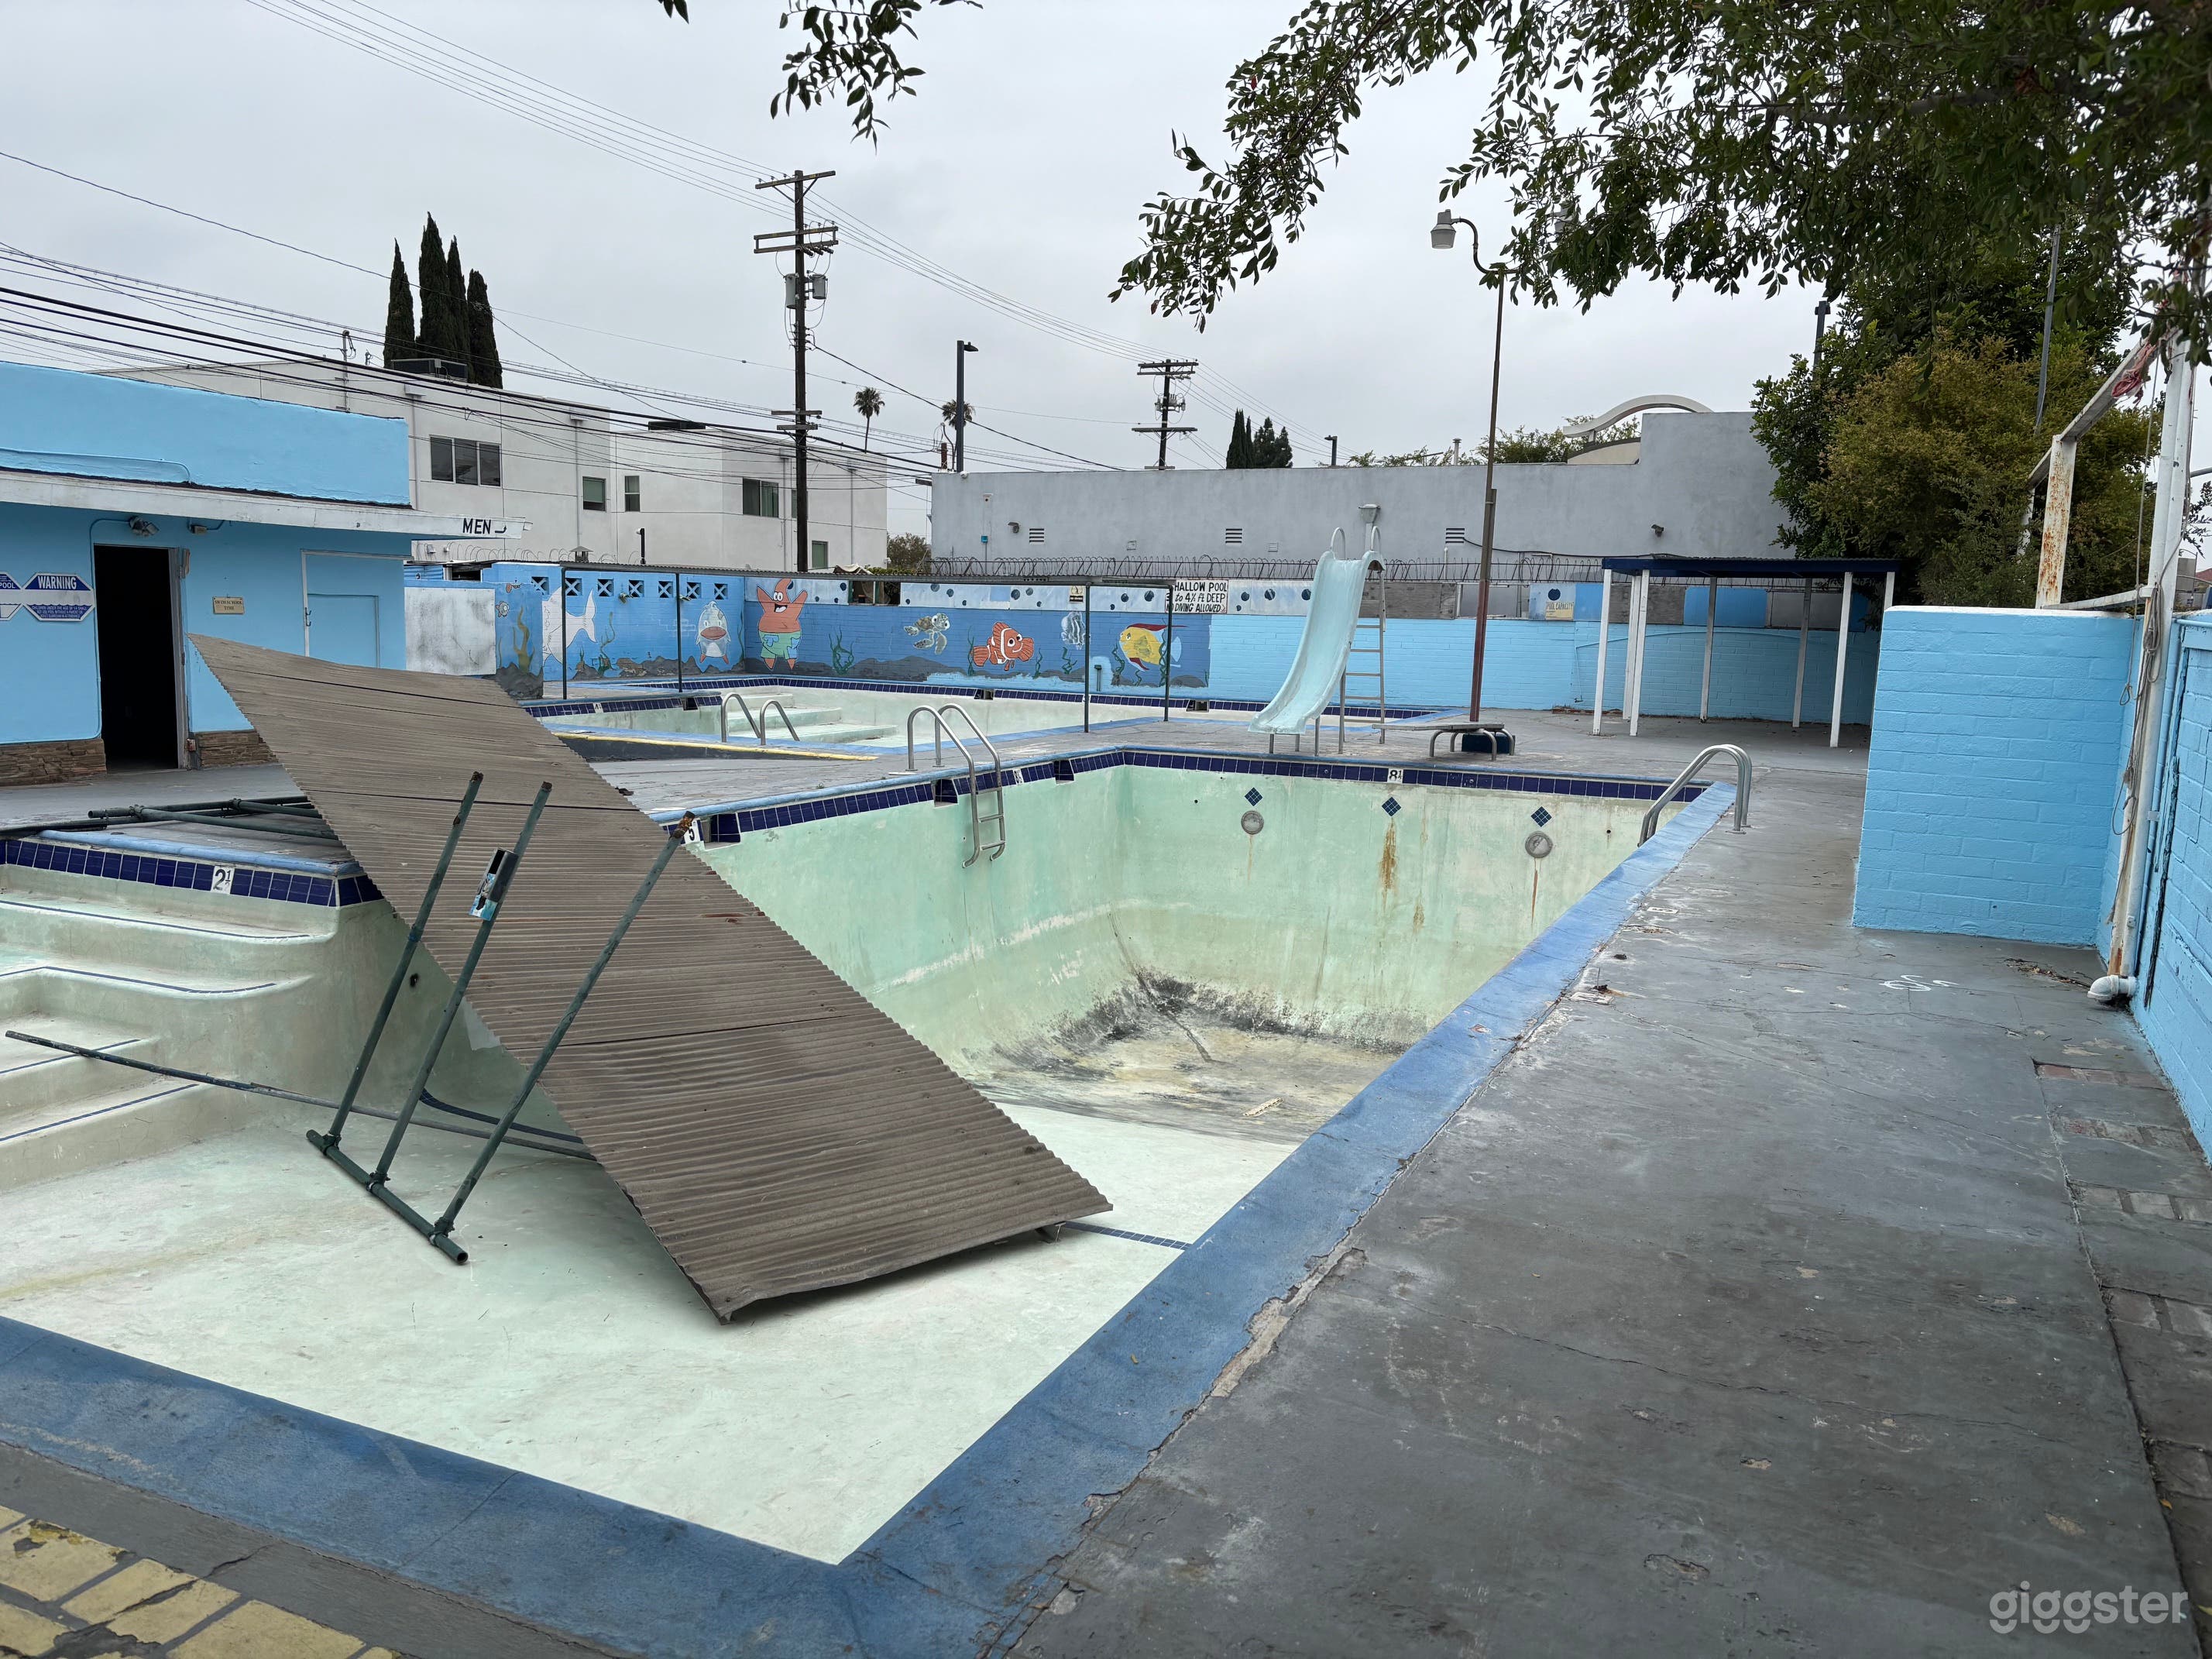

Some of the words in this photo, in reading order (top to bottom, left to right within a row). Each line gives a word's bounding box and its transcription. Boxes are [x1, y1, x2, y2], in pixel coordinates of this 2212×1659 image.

[462, 517, 492, 534] MEN
[37, 575, 77, 589] WARNING
[1208, 582, 1228, 592] POOL
[1175, 592, 1183, 602] to
[1206, 593, 1226, 603] DEEP
[1174, 603, 1194, 612] DIVING
[1195, 604, 1221, 613] ALLOWED
